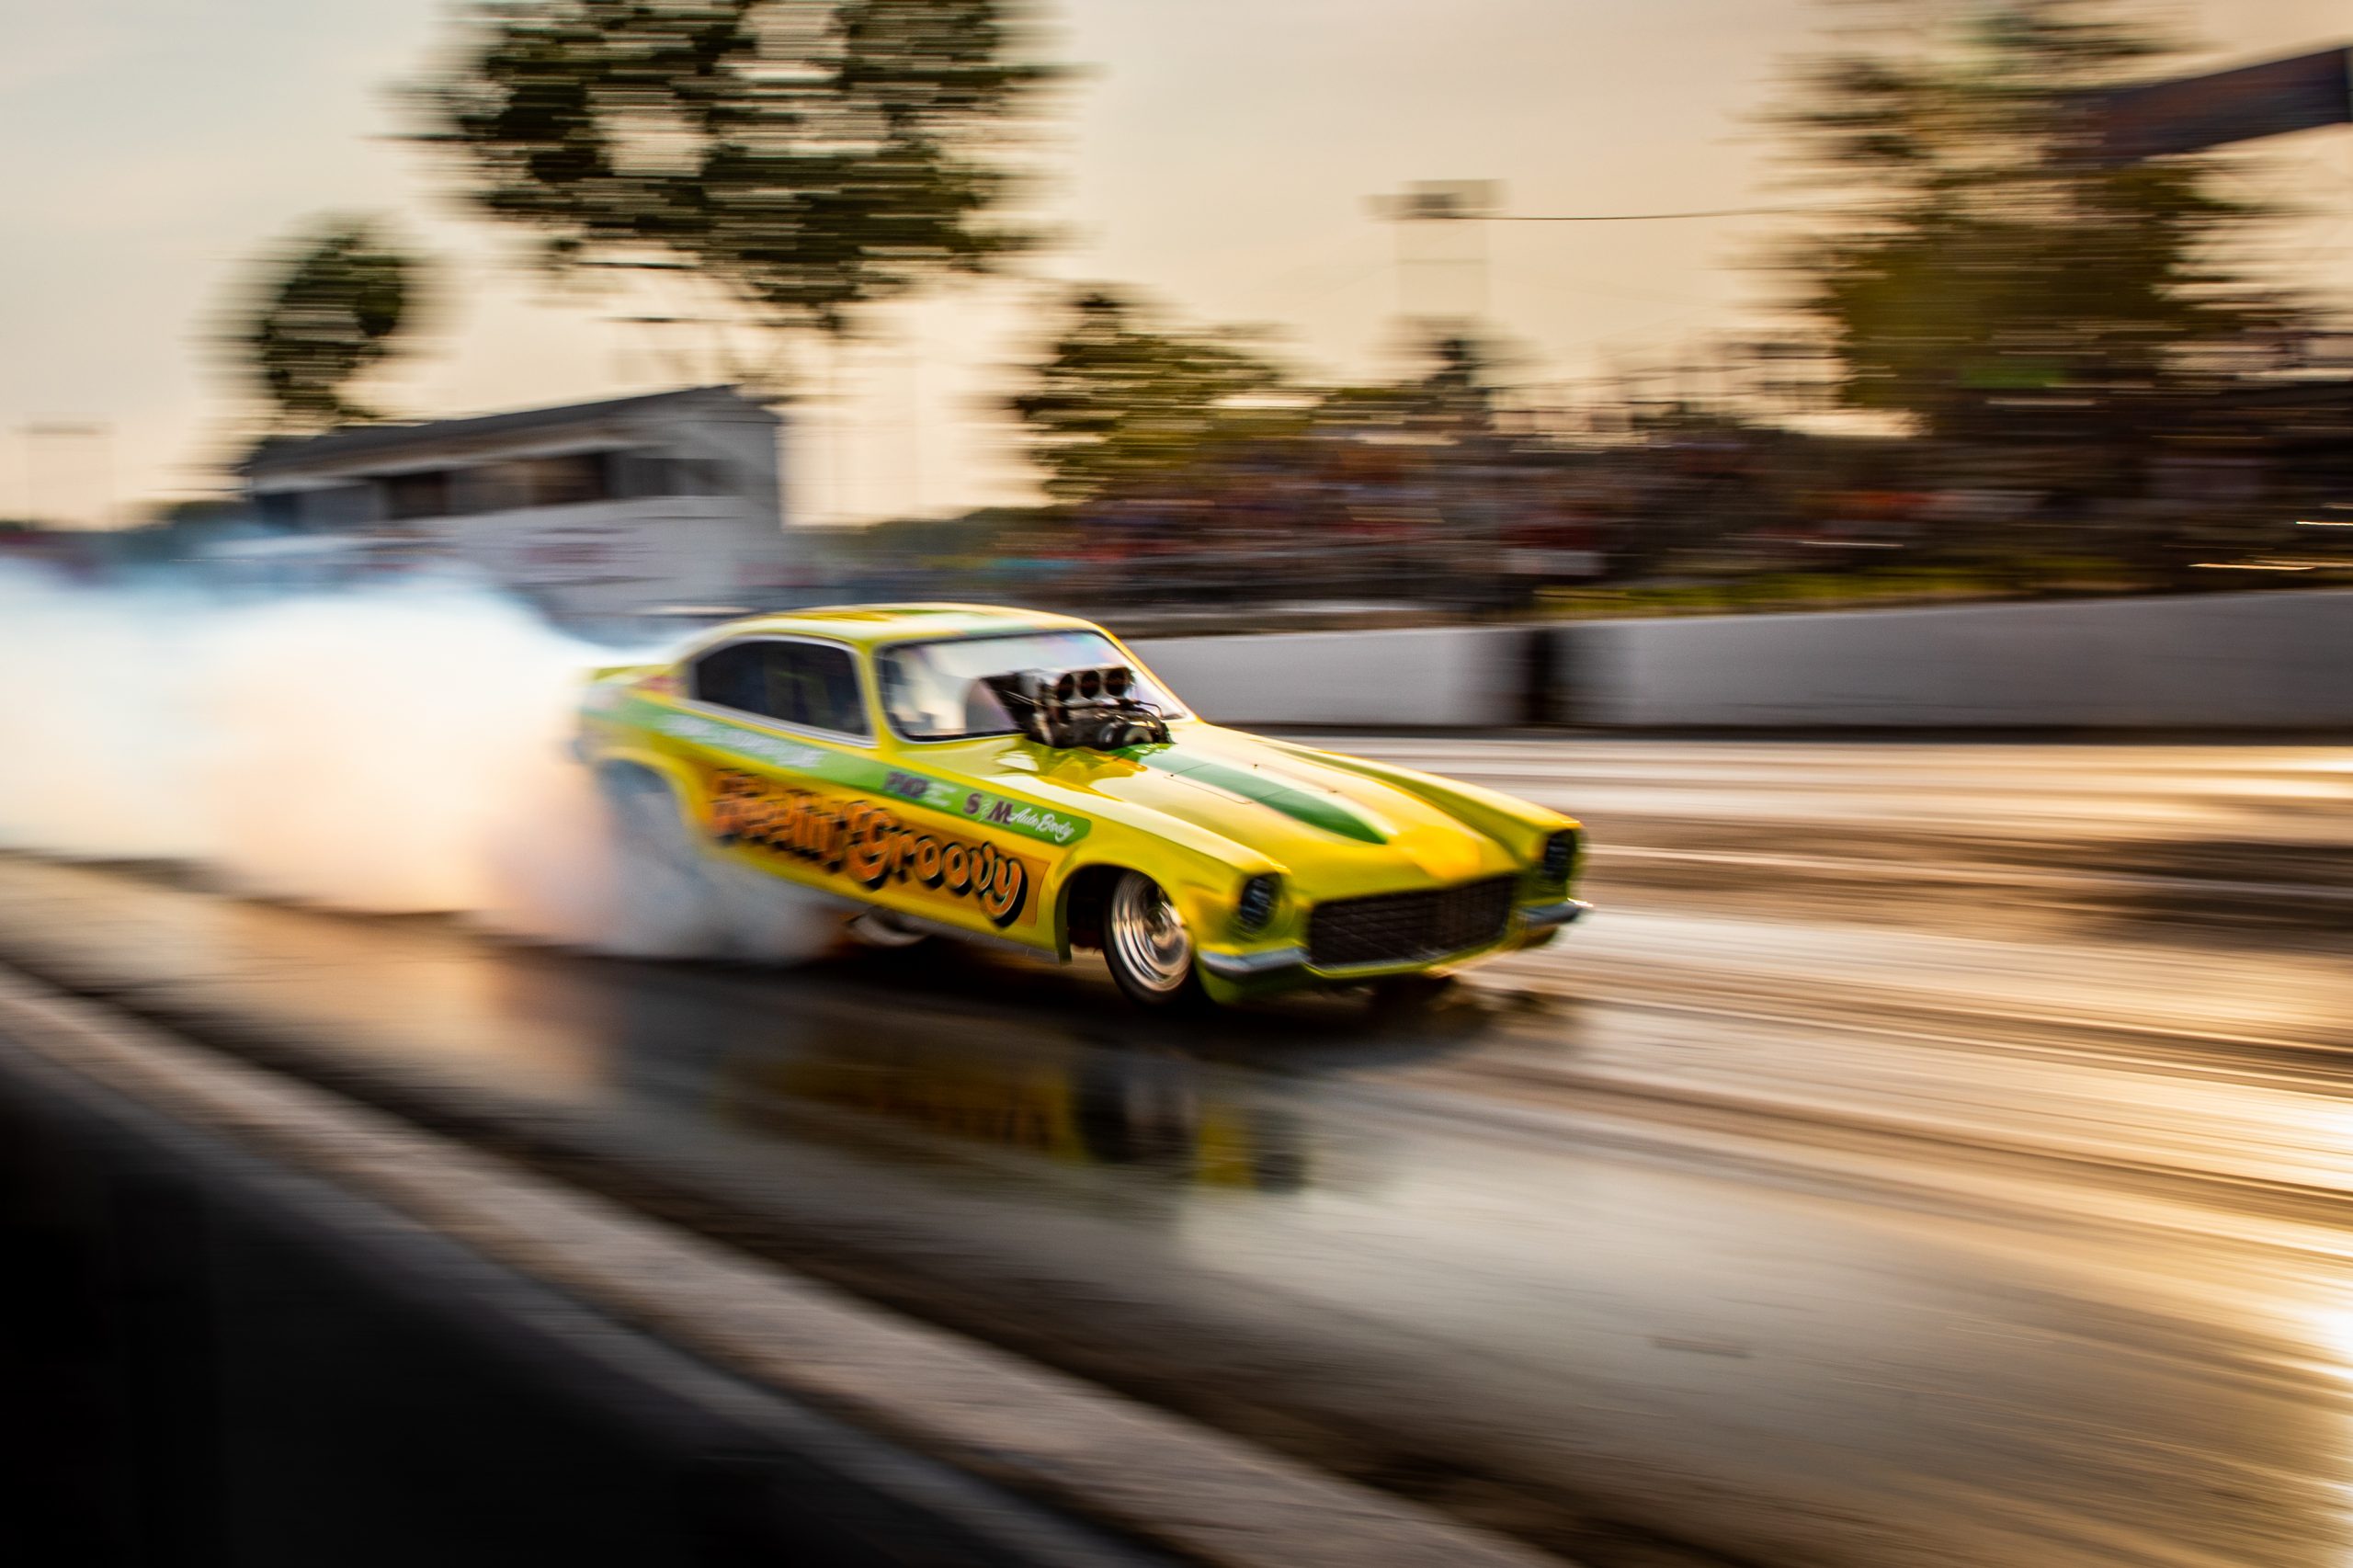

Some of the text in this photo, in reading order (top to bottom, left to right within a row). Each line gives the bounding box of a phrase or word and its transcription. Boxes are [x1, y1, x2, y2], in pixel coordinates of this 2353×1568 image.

[847, 800, 1027, 926] Groovy
[1006, 808, 1039, 827] Auto
[1036, 813, 1074, 842] Body
